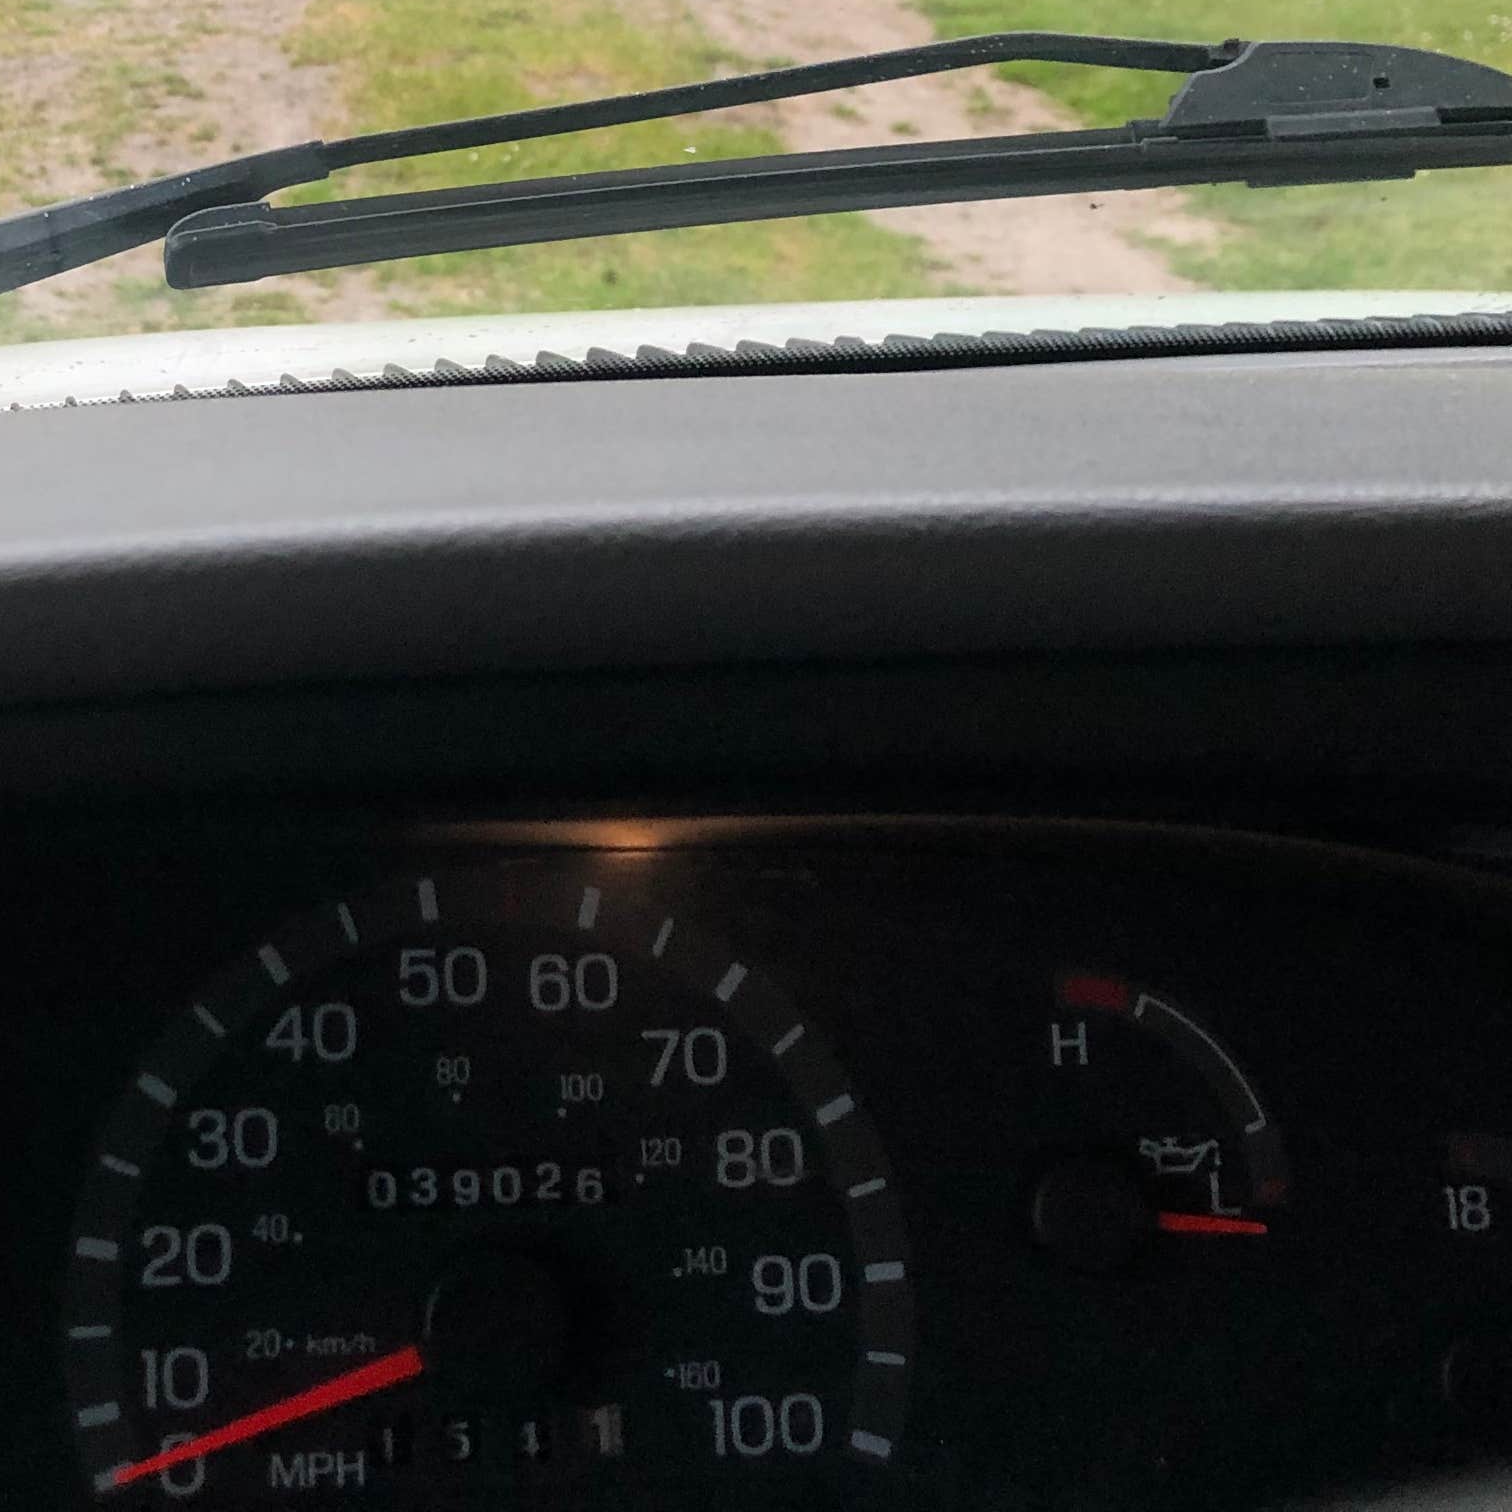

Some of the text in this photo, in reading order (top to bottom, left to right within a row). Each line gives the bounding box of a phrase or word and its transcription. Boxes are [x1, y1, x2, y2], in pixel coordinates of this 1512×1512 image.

[399, 946, 488, 1006] 50
[529, 952, 618, 1012] 60
[265, 1002, 358, 1063] 40
[640, 1026, 727, 1087] 70
[1050, 1021, 1089, 1066] H
[435, 1055, 471, 1086] 80
[559, 1073, 604, 1102] 100
[188, 1107, 278, 1169] 30
[640, 1137, 683, 1167] 120
[716, 1127, 804, 1189] 80
[368, 1161, 604, 1208] 039026
[1443, 1185, 1491, 1232] 18
[141, 1223, 232, 1287] 20
[751, 1253, 842, 1316] 90
[141, 1347, 210, 1410] 10
[708, 1392, 824, 1456] 100
[269, 1451, 366, 1489] MPH
